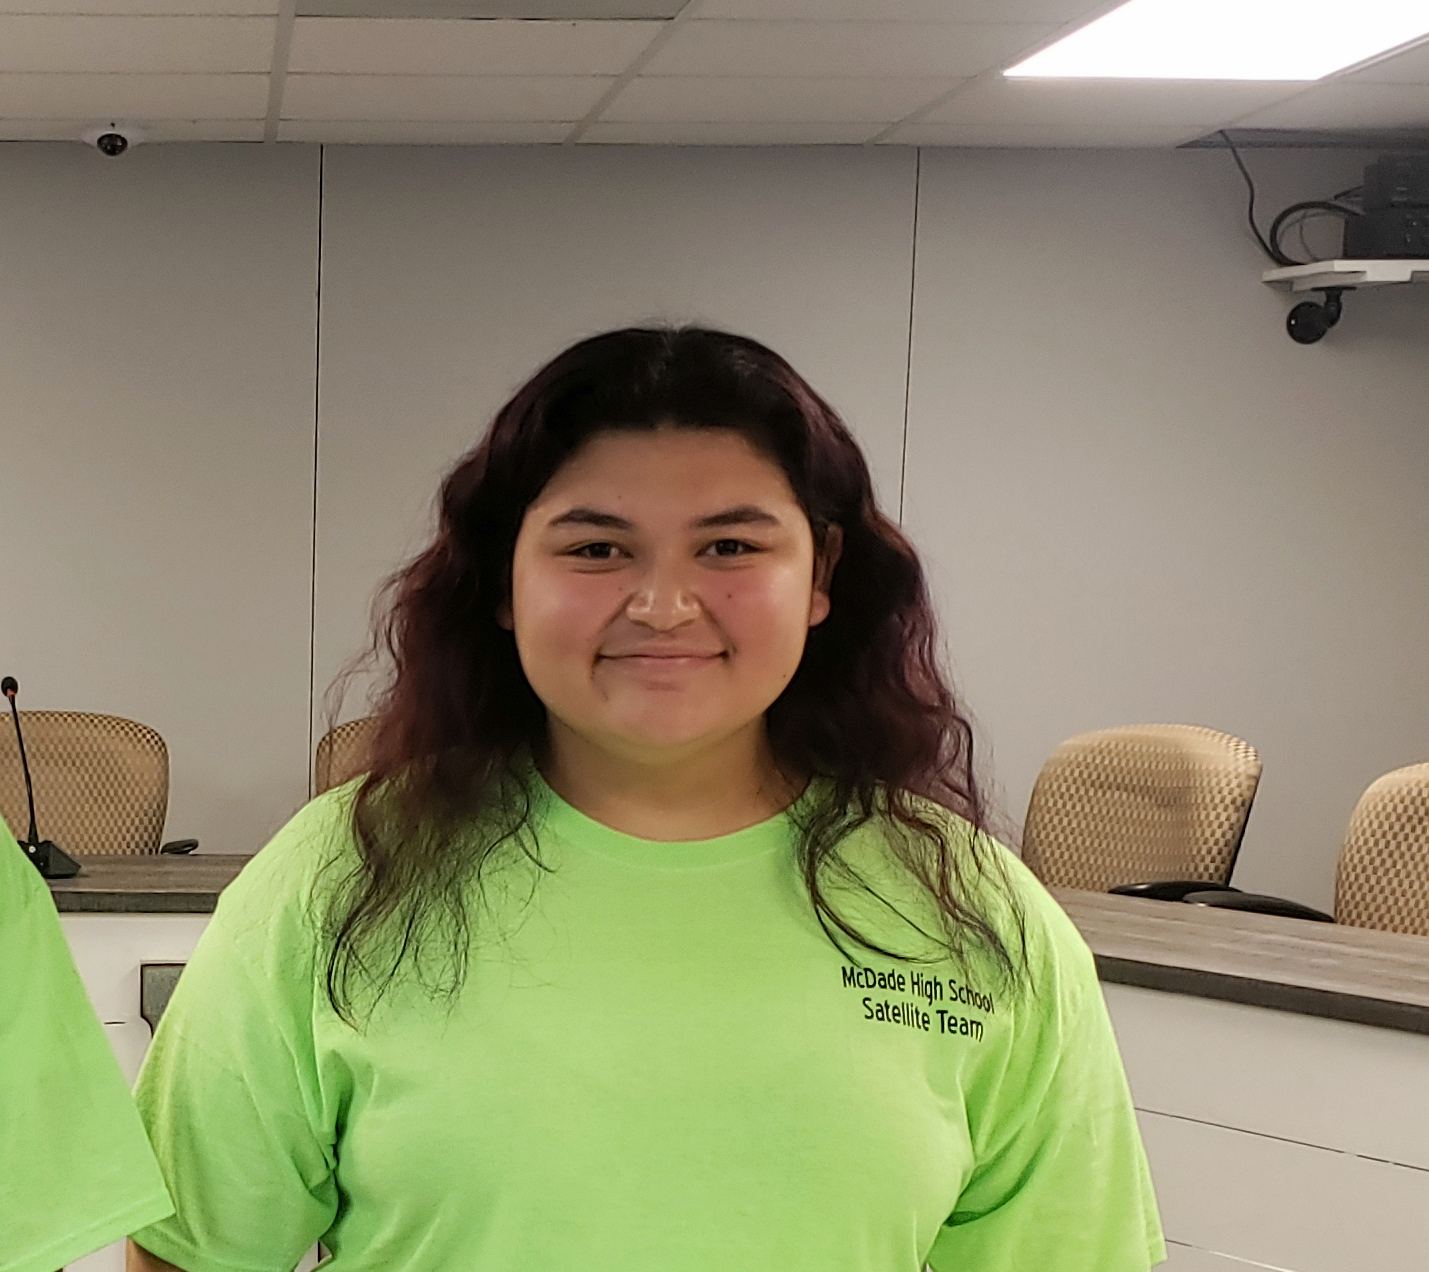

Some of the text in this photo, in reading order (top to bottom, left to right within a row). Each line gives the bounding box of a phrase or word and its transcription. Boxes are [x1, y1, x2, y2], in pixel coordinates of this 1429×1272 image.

[841, 965, 996, 1015] McDade High School
[862, 996, 984, 1042] Satellite Team
